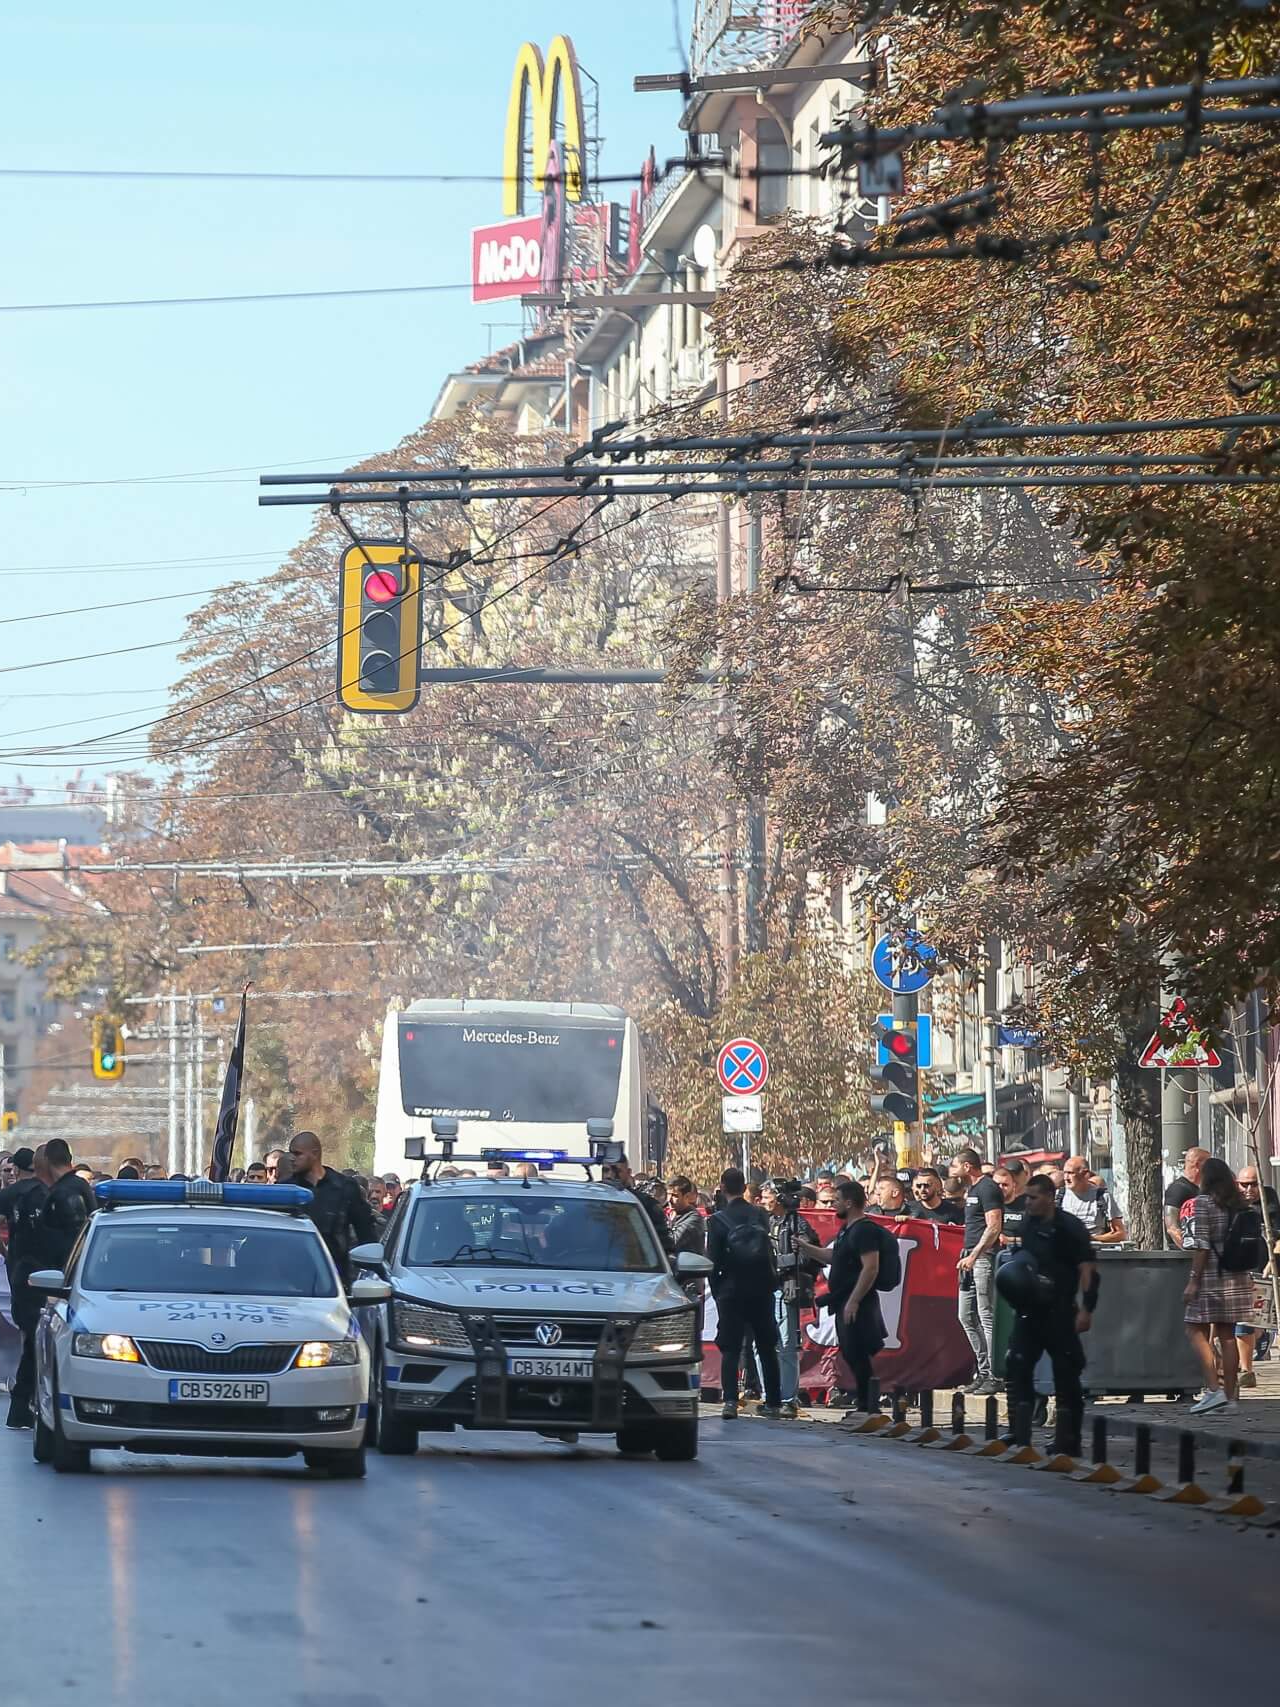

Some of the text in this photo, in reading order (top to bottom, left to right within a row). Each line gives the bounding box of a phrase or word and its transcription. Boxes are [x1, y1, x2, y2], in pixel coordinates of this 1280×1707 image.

[462, 1028, 560, 1045] Mercedes-Benz
[413, 1107, 491, 1119] TOURISMO
[475, 1284, 615, 1296] POLICE
[139, 1302, 289, 1315] POLICE
[168, 1312, 264, 1324] 24-1179
